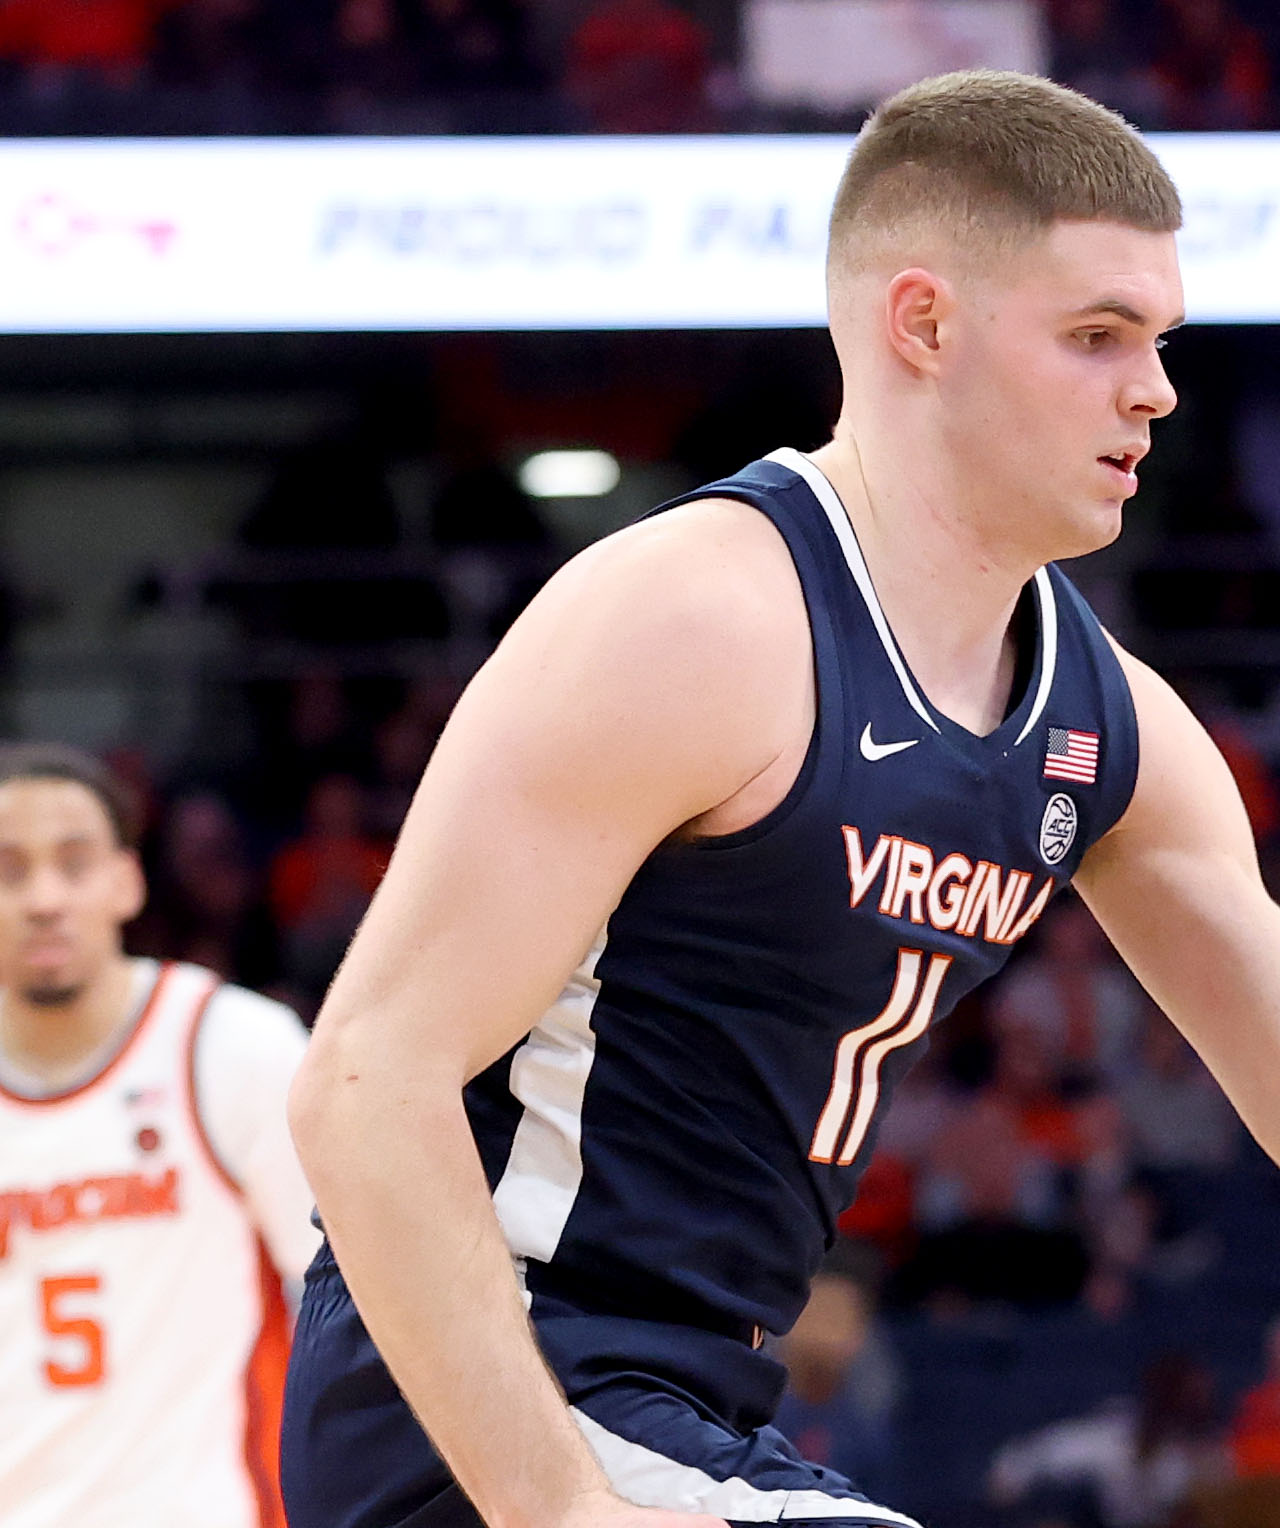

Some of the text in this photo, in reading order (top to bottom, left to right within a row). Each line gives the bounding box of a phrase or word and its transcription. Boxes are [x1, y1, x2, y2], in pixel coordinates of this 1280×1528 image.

[1048, 818, 1074, 835] ACC
[807, 947, 953, 1166] 11
[42, 1276, 103, 1386] 5
